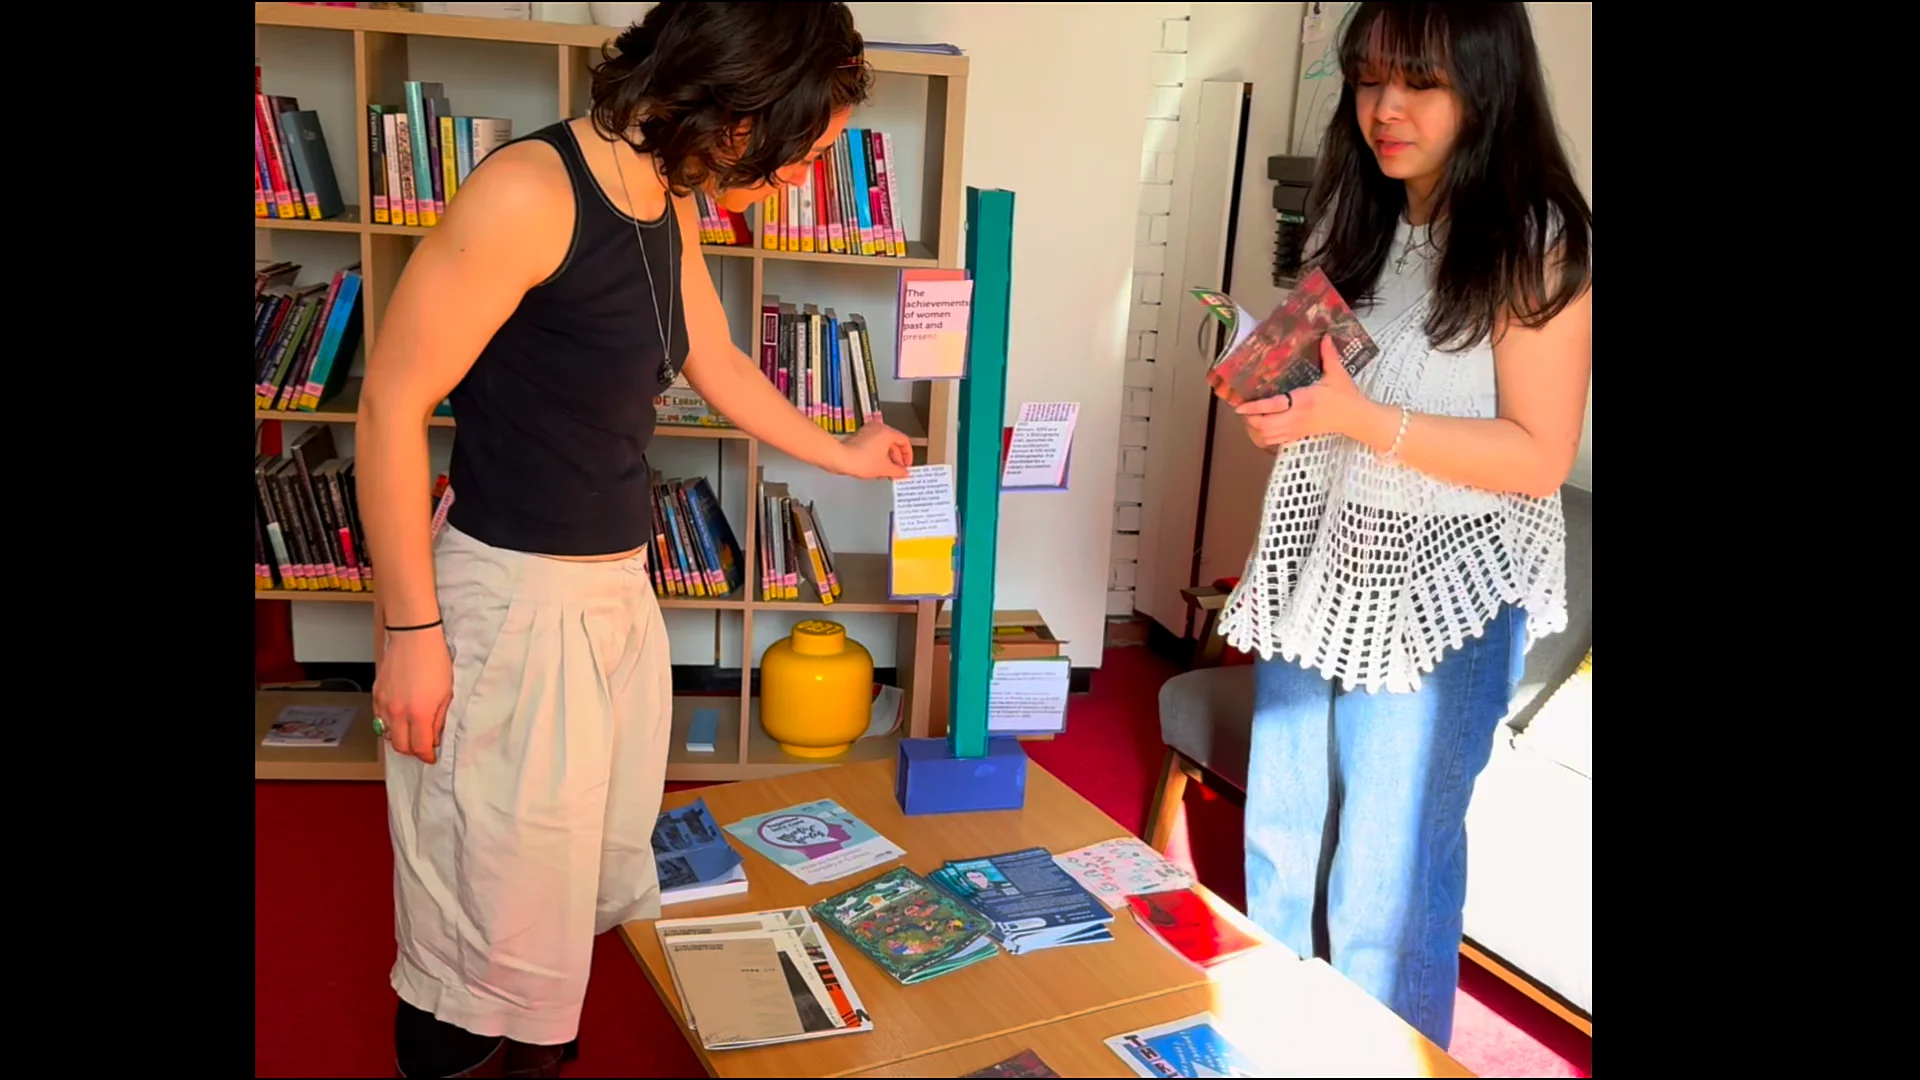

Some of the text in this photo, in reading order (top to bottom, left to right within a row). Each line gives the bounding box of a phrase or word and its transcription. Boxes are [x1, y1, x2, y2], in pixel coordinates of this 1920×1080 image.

[907, 289, 925, 297] The
[906, 300, 969, 308] achievements
[904, 311, 914, 319] of
[903, 321, 943, 331] past and
